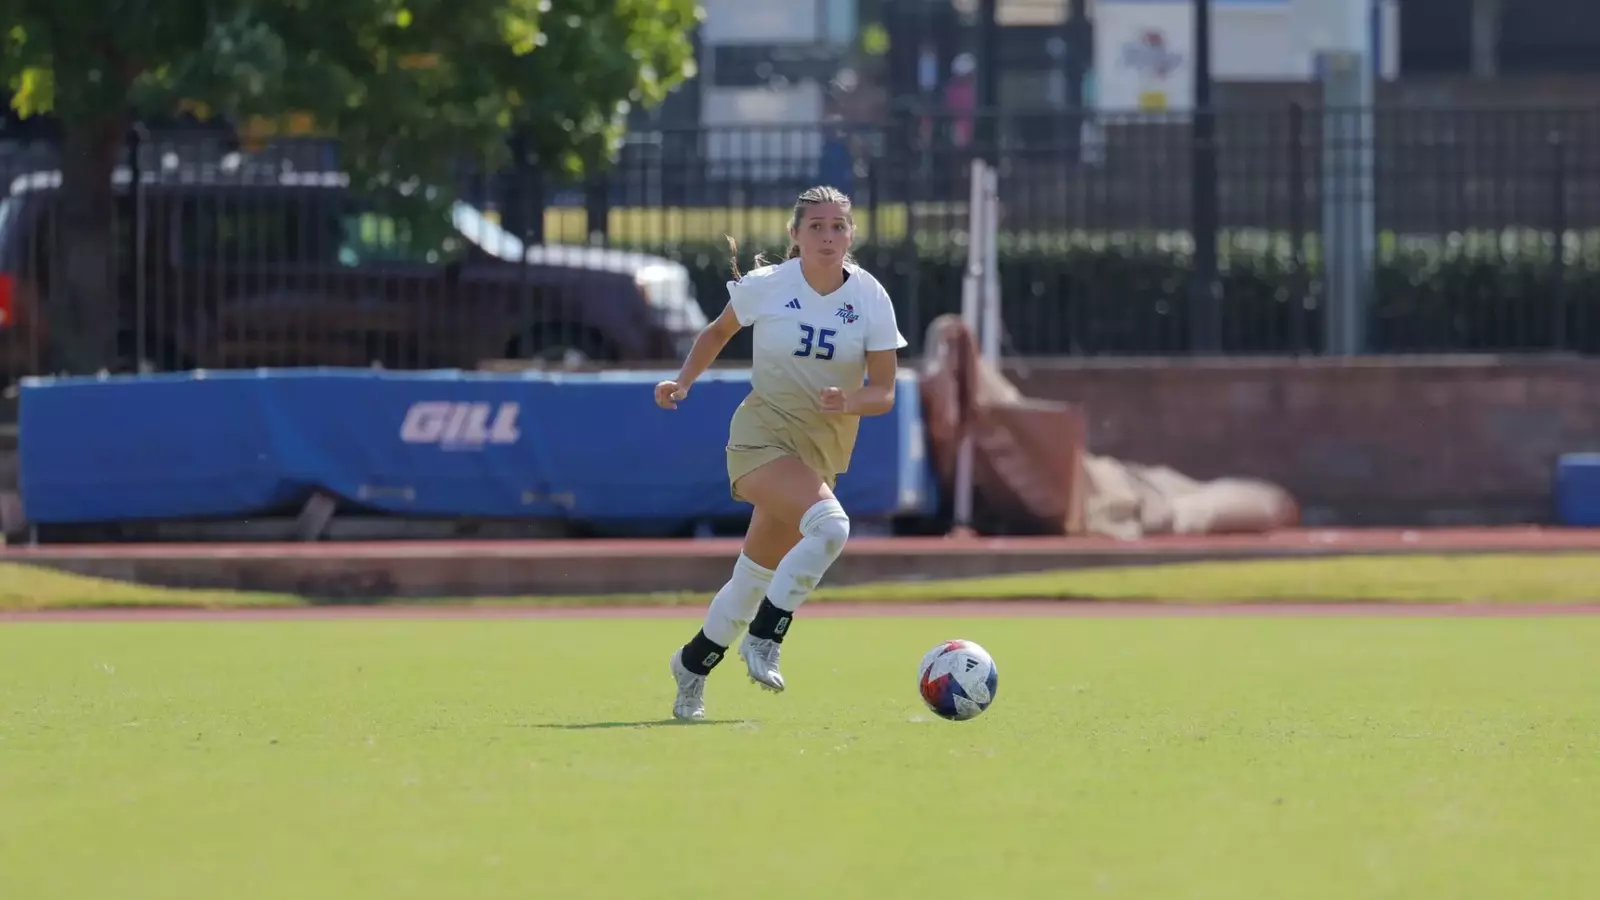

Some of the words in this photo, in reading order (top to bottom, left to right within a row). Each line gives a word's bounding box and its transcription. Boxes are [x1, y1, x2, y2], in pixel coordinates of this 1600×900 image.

[835, 307, 859, 321] Tulsa
[794, 324, 836, 360] 35
[400, 401, 520, 443] GILL
